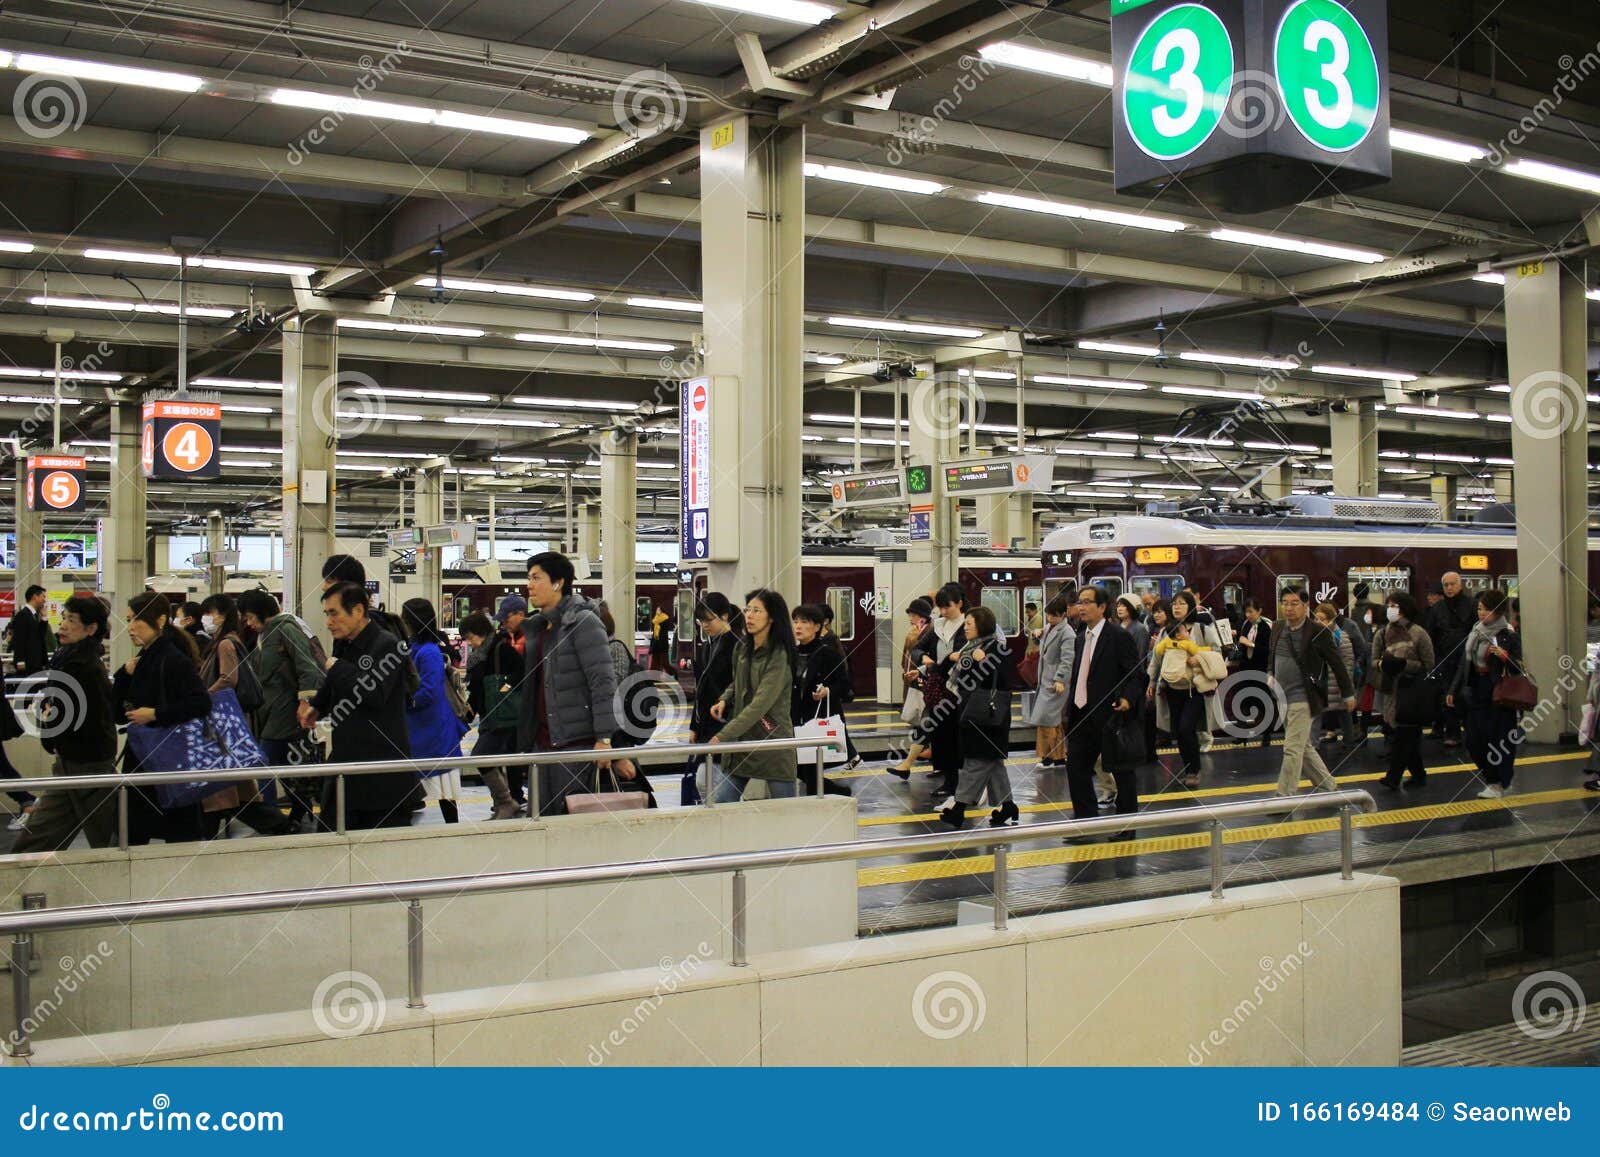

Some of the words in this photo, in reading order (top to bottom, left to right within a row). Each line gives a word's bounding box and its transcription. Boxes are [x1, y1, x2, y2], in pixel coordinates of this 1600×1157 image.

[1151, 28, 1204, 137] 3
[1303, 19, 1353, 129] 3
[174, 430, 200, 465] 4
[51, 476, 70, 503] 5
